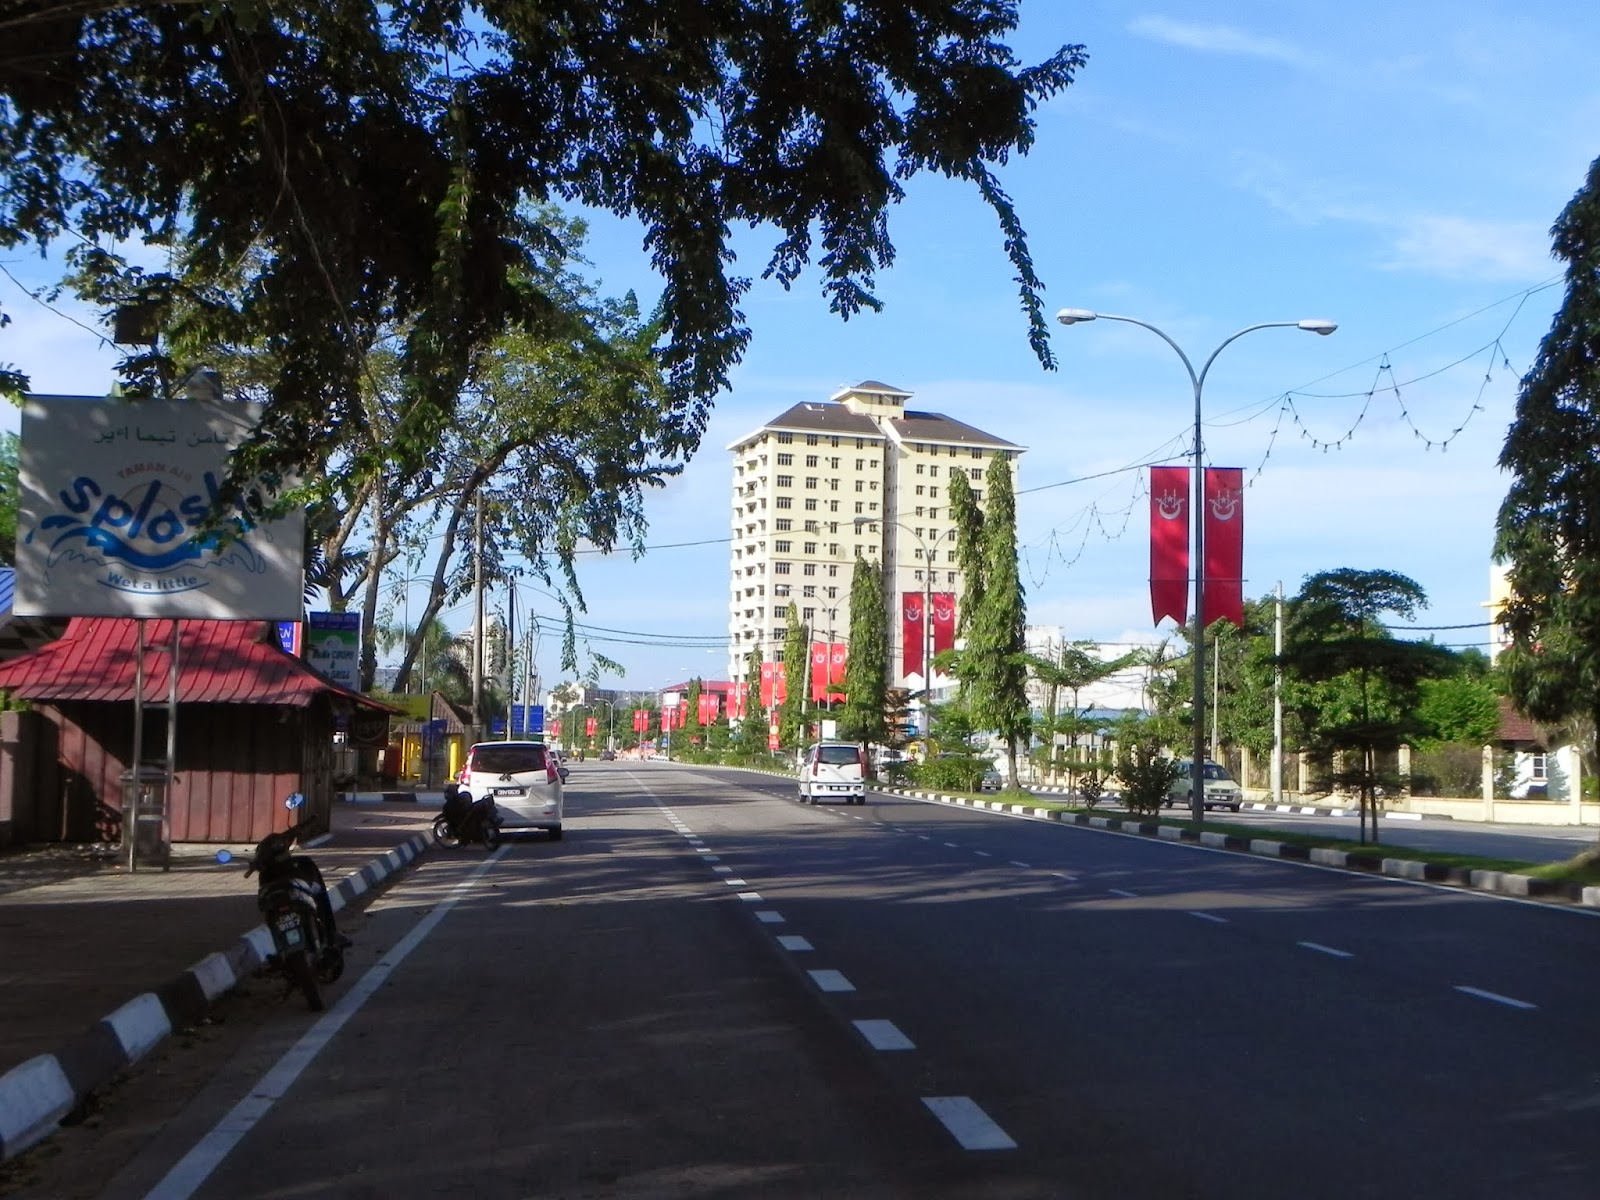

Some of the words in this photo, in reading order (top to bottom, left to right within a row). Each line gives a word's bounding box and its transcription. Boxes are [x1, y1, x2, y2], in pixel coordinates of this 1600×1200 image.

[118, 462, 166, 479] TAMAN
[169, 466, 193, 483] AIR
[108, 571, 138, 590] Wet
[142, 581, 153, 590] a
[157, 573, 198, 590] little
